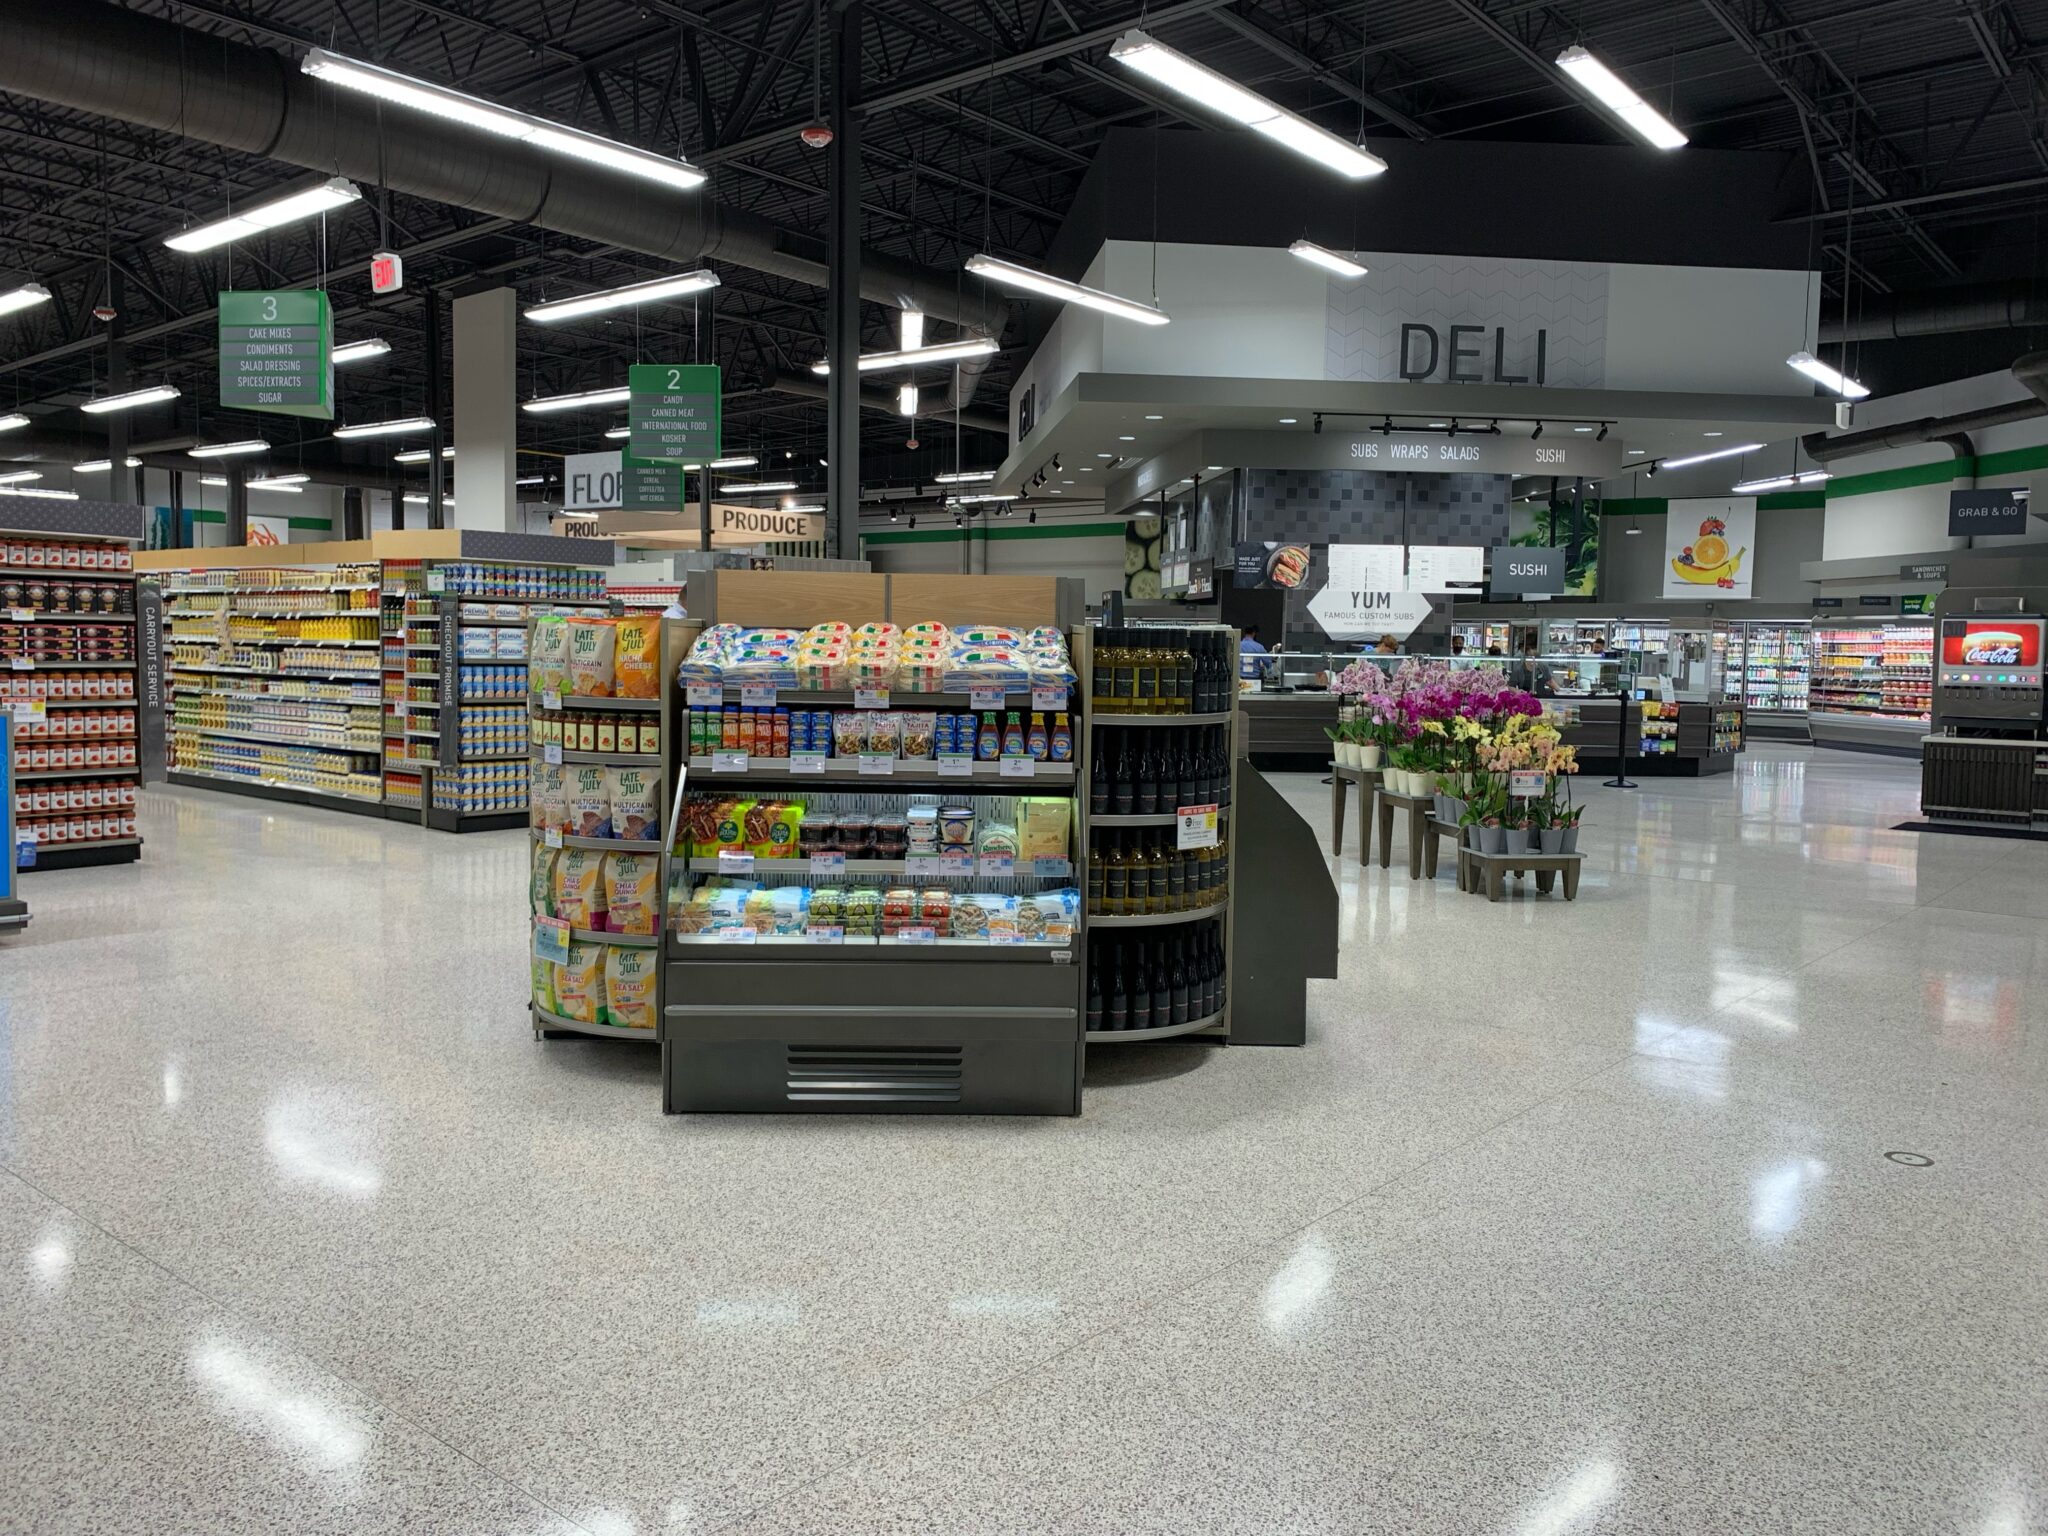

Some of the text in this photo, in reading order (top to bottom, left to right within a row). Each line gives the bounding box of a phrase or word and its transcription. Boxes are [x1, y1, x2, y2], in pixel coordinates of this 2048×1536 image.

[262, 296, 277, 321] 3
[249, 328, 292, 338] CAKE MIXES
[246, 344, 293, 355] CONDIMENTS
[1400, 323, 1546, 384] DELI
[240, 360, 301, 371] SALAD DRESSING
[238, 376, 301, 387] SPICES/EXTRACTS
[667, 369, 681, 390] 2
[258, 392, 282, 403] SUGAR
[663, 395, 683, 404] CANDY
[651, 408, 694, 417] CANNED MEAT
[641, 422, 707, 430] INTERNATIONAL FOOD
[661, 434, 686, 443] KOSHER
[666, 447, 683, 456] SOUP
[1351, 444, 1480, 461] SUBS WRAPS SALADS
[1535, 449, 1565, 463] SUSHI
[1958, 506, 2018, 517] GRAB & GO
[723, 509, 808, 535] PRODUCE
[1509, 563, 1547, 576] SUSHI
[1351, 592, 1391, 609] YUM
[1360, 612, 1391, 620] CUSTOM
[1394, 612, 1415, 620] SUBS
[574, 629, 595, 643] LATE
[622, 628, 642, 641] LATE
[575, 640, 597, 654] JULY
[623, 639, 646, 652] JULY
[145, 606, 158, 708] CARRYOUT SERVICE
[444, 615, 453, 706] CHECKOUT PROMISE
[546, 769, 560, 782] LATE
[578, 769, 598, 782] LATE
[620, 771, 640, 786] LATE
[546, 779, 563, 792] JULY
[580, 779, 602, 793] JULY
[621, 782, 645, 797] JULY
[566, 858, 585, 871] JULY
[616, 855, 635, 867] LATE
[618, 863, 640, 877] JULY
[618, 952, 639, 965] LATE
[619, 962, 642, 976] JULY
